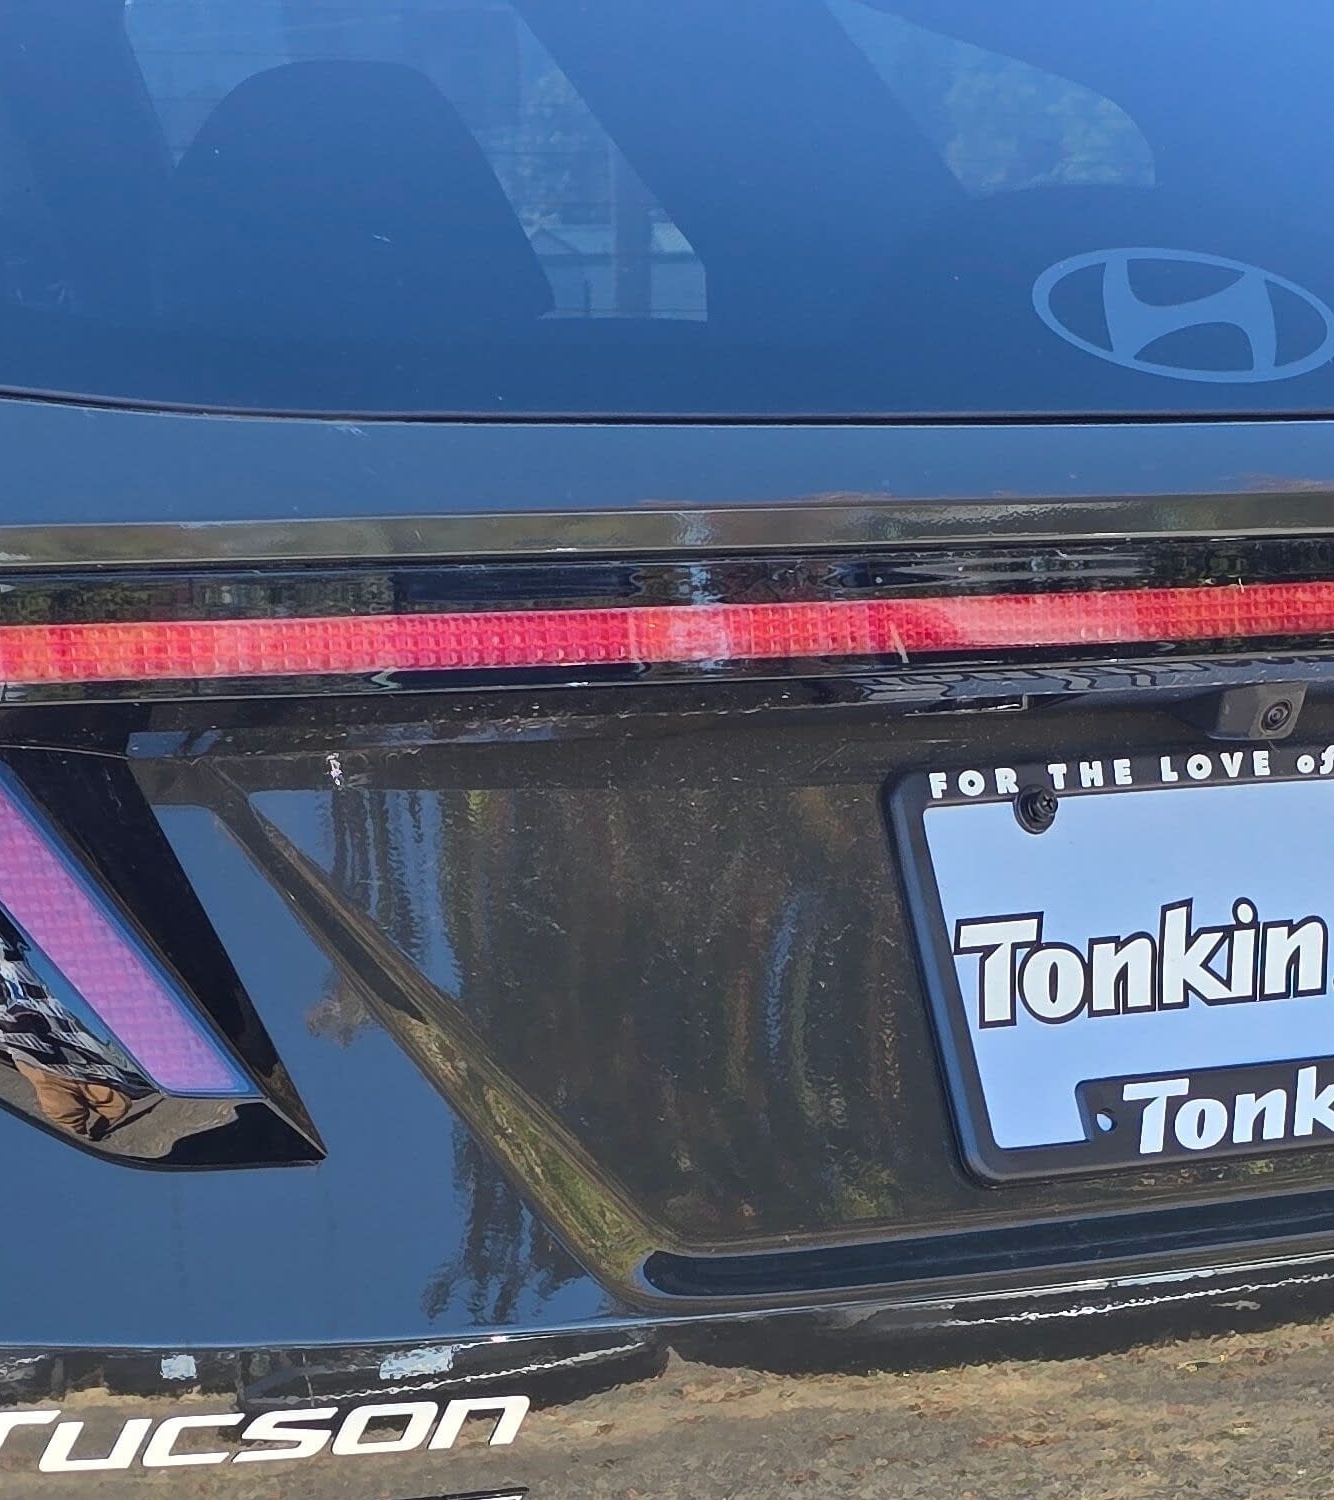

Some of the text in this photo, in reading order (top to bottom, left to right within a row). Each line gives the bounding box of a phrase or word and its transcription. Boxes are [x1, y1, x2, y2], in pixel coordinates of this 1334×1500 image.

[928, 766, 1020, 799] FOR
[1047, 758, 1134, 791] THE
[1160, 750, 1272, 782] LOVE
